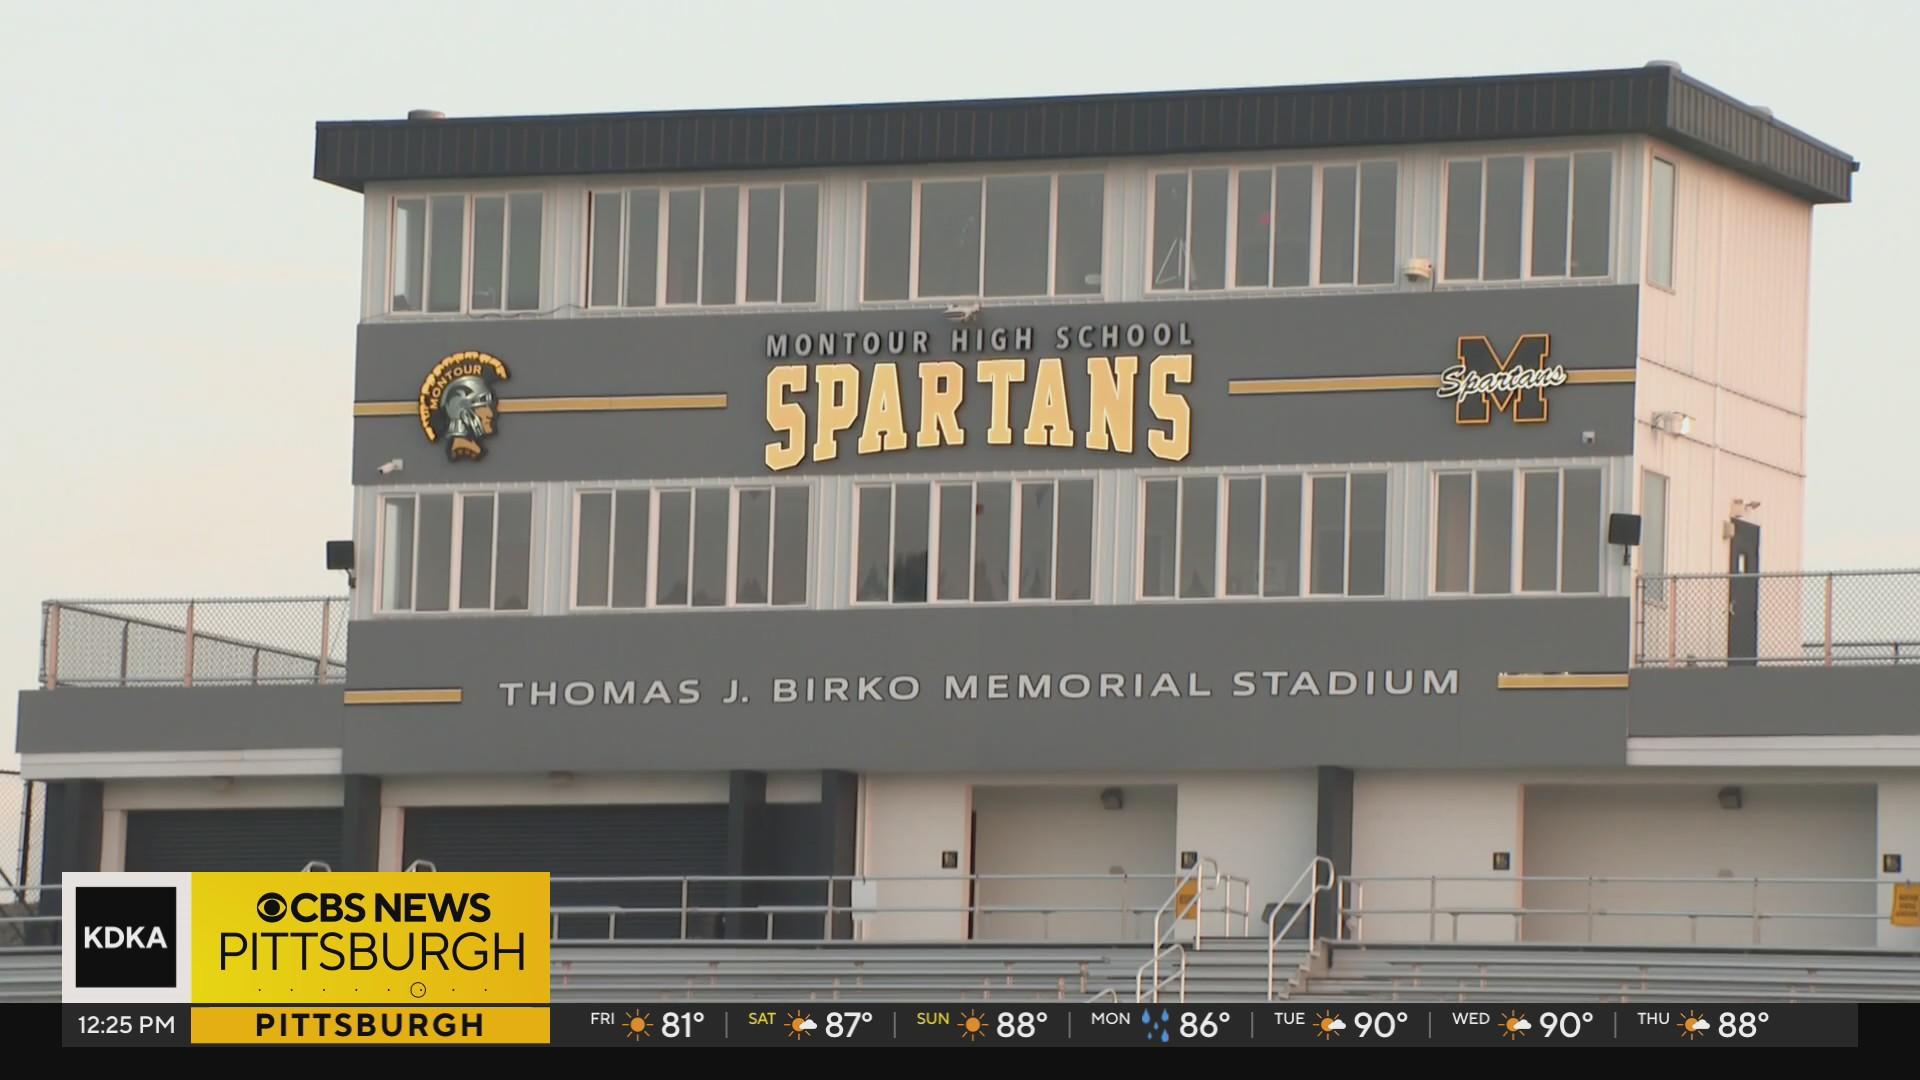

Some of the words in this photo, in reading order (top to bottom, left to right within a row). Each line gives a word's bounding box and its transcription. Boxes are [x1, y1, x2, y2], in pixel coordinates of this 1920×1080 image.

[765, 331, 930, 358] MONTOUR
[951, 327, 1034, 353] HIGH
[1056, 322, 1194, 350] SCHOOL
[430, 364, 482, 410] MONTOUR
[1437, 364, 1567, 403] Spartans
[764, 353, 1194, 471] SPARTANS
[499, 679, 700, 706] THOMAS
[722, 680, 750, 703] J.
[773, 675, 920, 703] BIRKO
[944, 671, 1211, 700] MEMORIAL
[1232, 669, 1459, 696] STADIUM
